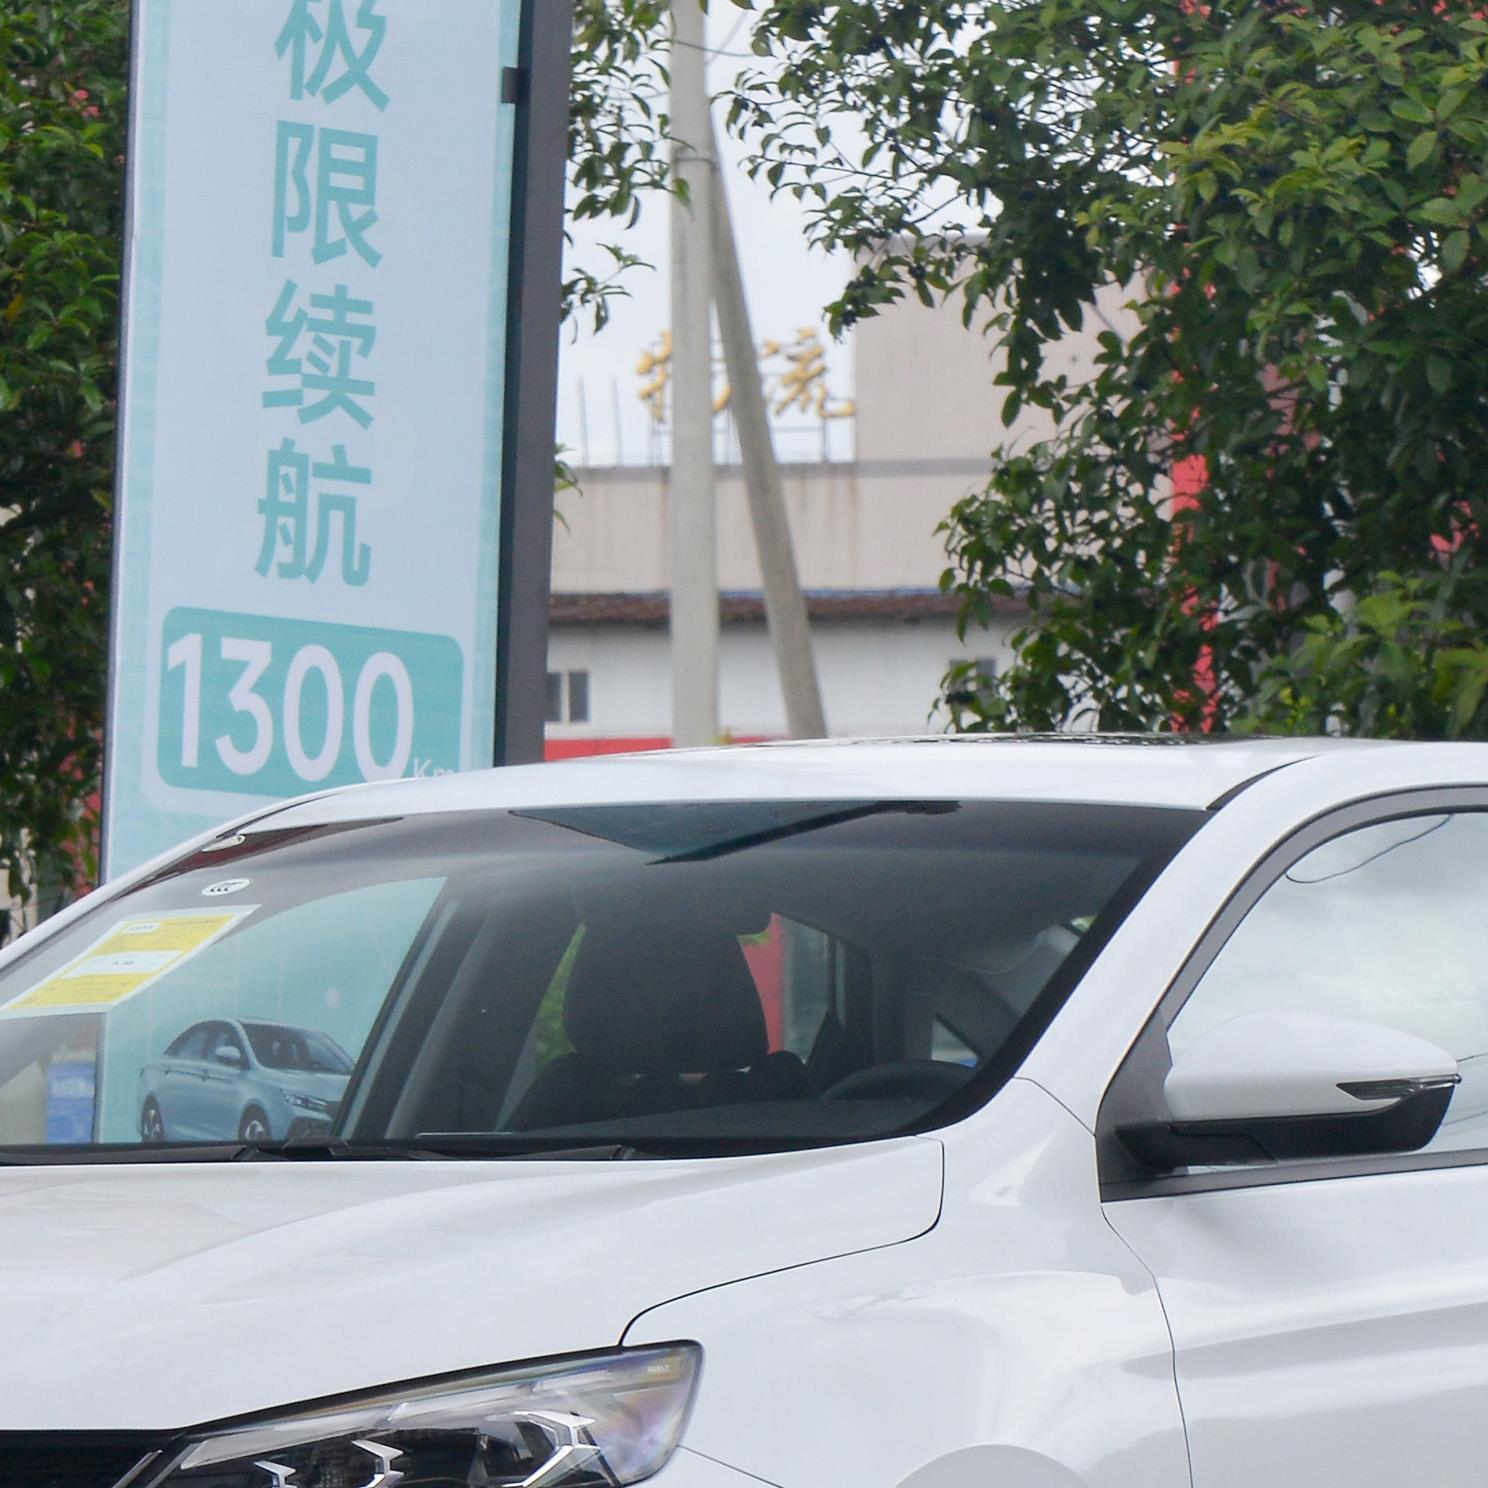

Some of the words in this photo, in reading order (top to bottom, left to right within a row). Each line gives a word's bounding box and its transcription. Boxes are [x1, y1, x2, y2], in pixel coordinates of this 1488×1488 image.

[255, 0, 391, 587] 极限续航
[167, 633, 414, 783] 1300
